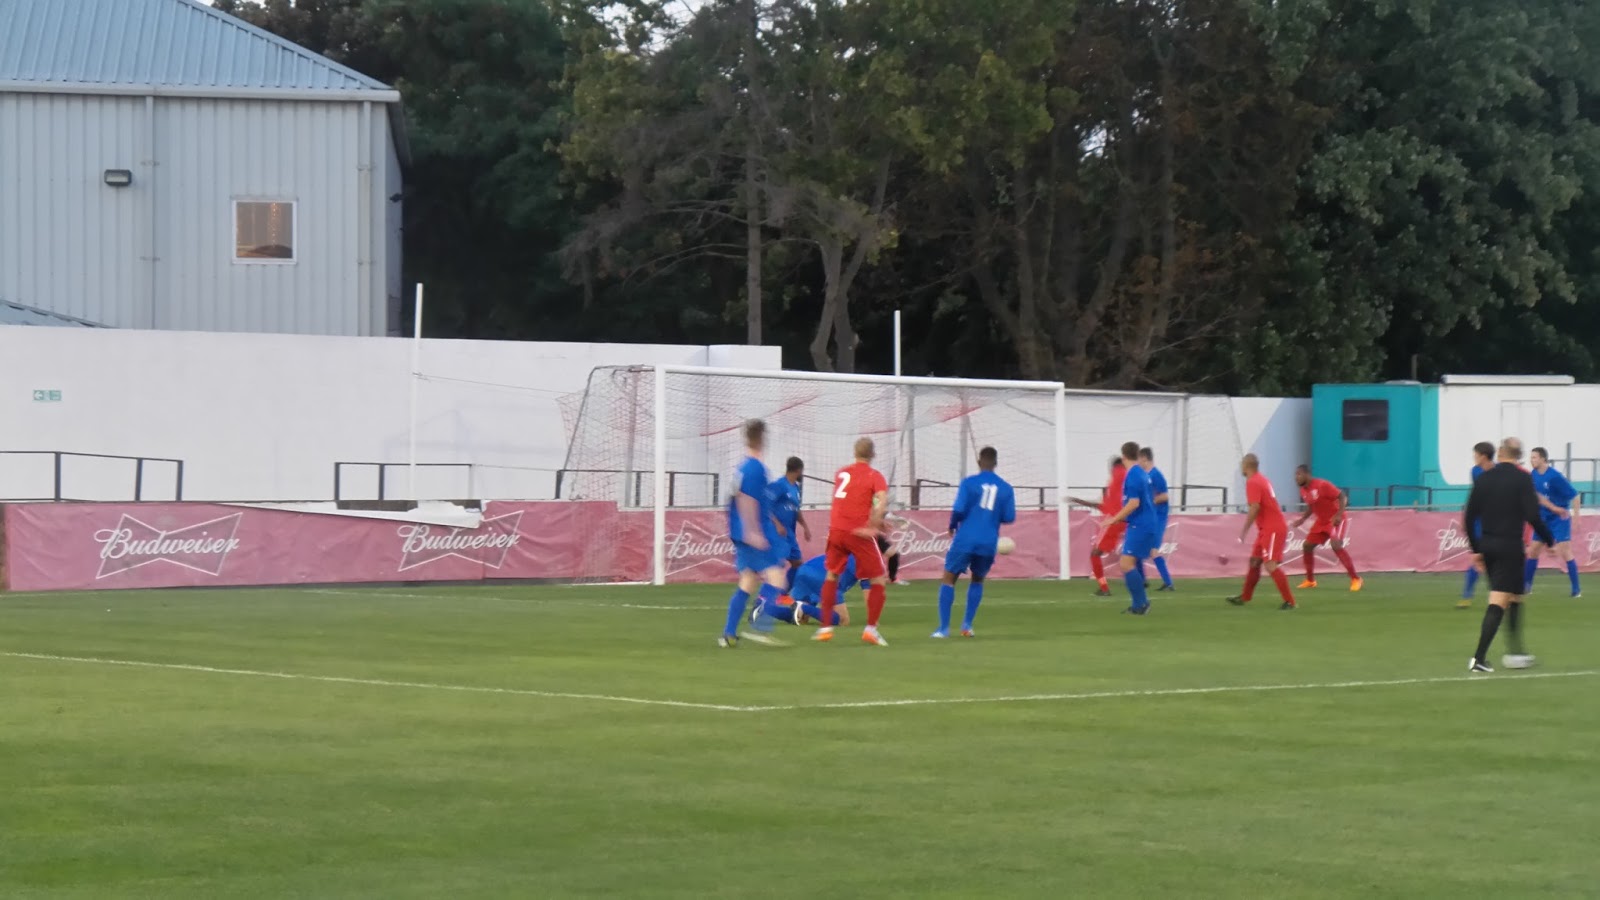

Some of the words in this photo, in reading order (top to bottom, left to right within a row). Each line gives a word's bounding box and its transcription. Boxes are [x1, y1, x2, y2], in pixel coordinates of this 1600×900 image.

[835, 471, 851, 498] 2
[980, 483, 998, 511] 11
[94, 528, 240, 559] Budweiser
[397, 525, 520, 553] Budweiser
